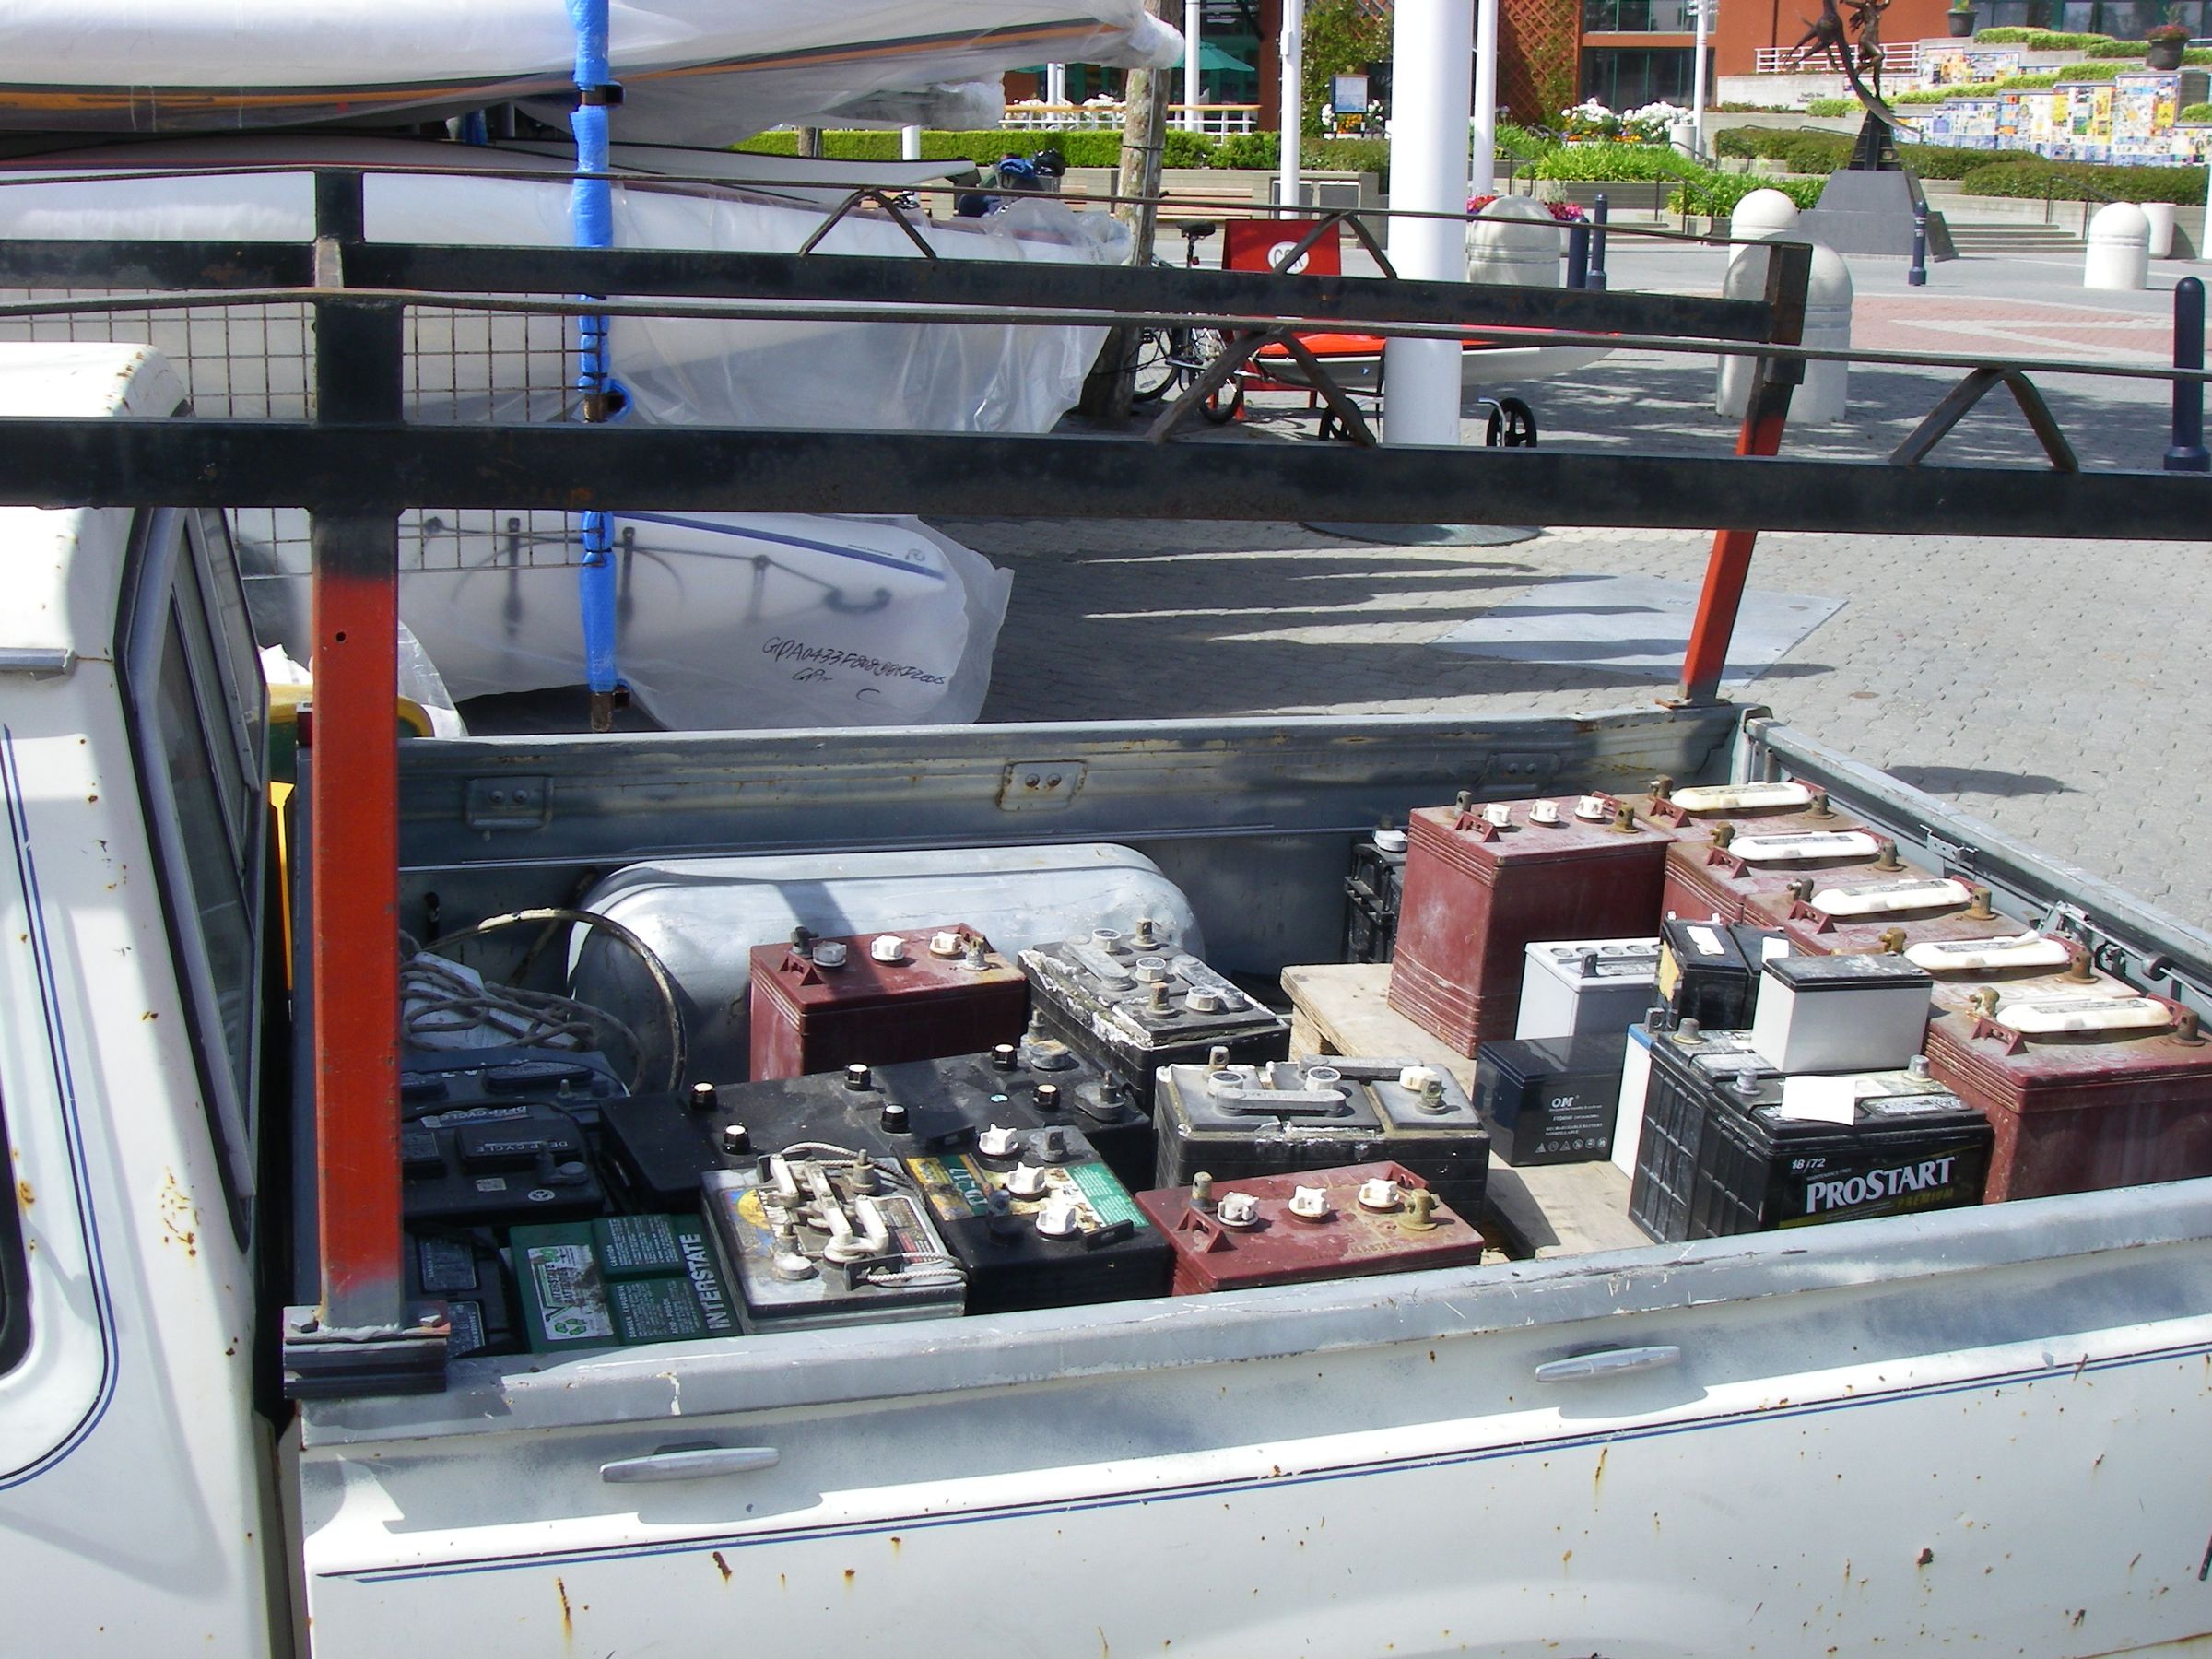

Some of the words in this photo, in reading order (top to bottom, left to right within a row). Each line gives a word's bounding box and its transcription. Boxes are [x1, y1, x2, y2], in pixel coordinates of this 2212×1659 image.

[1551, 1096, 1574, 1109] OM
[531, 1141, 568, 1150] DEP
[1791, 1158, 1826, 1173] 18/72
[1895, 1187, 1955, 1210] PREMIUM
[606, 1244, 618, 1267] CAUTION
[679, 1233, 731, 1330] INTERSTATE
